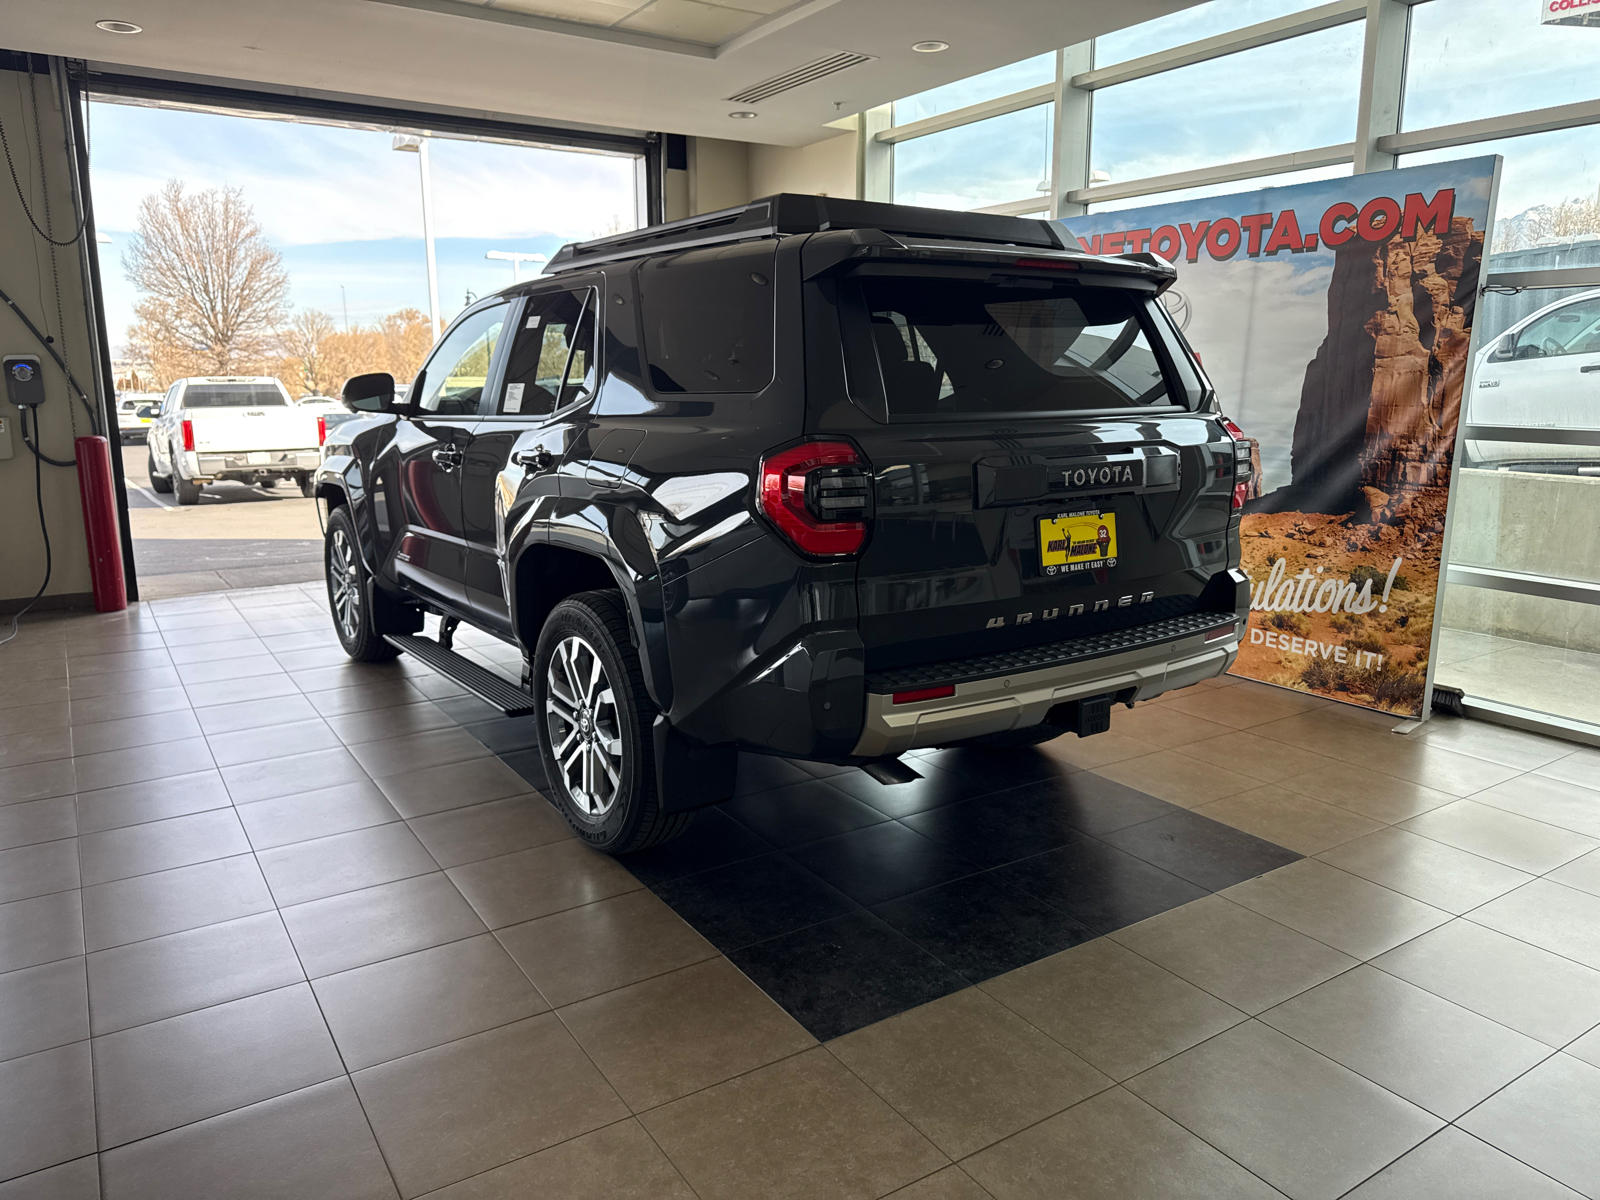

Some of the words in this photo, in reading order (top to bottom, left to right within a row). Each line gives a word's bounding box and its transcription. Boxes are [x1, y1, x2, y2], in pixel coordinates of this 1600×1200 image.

[1549, 0, 1600, 12] COLL
[1061, 465, 1133, 487] TOYOTA
[1099, 529, 1107, 538] 32
[1047, 539, 1067, 553] KARL
[1069, 542, 1098, 557] MALONE
[1061, 565, 1069, 573] WE
[1070, 562, 1084, 571] MAKE
[1085, 561, 1090, 569] IT
[1091, 560, 1104, 569] EASY
[985, 590, 1155, 630] 4RUNNER
[1250, 627, 1348, 664] DESERVE
[1355, 650, 1384, 672] IT!
